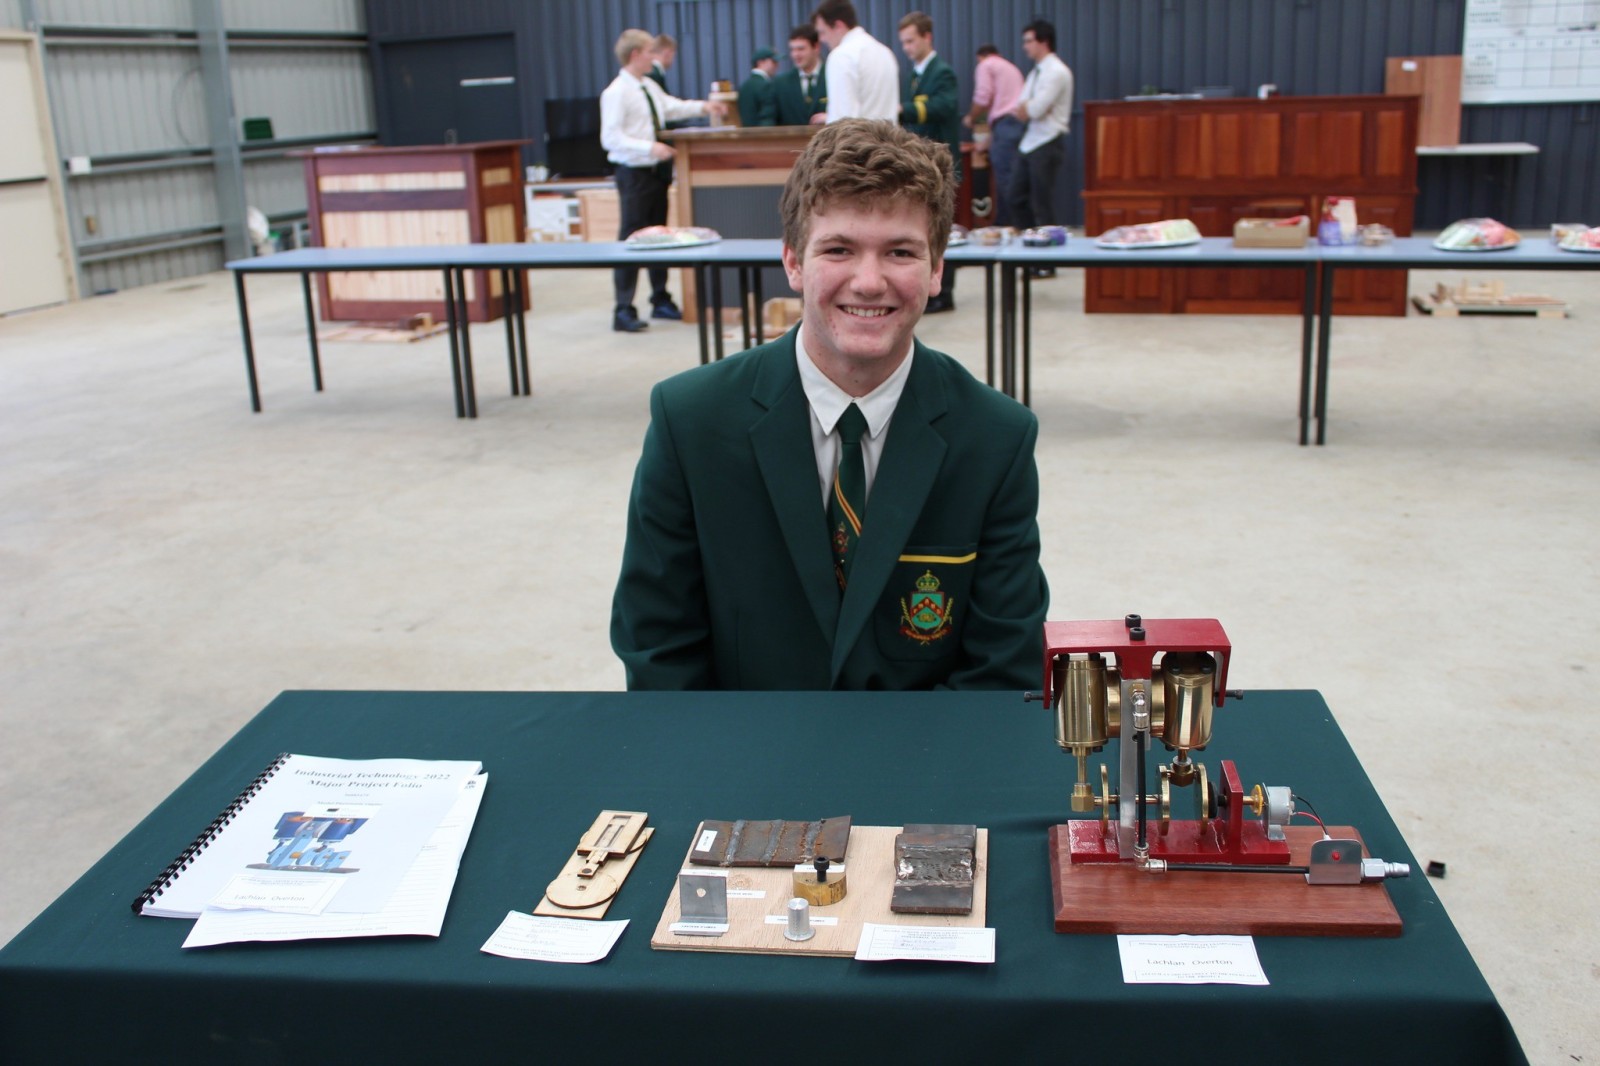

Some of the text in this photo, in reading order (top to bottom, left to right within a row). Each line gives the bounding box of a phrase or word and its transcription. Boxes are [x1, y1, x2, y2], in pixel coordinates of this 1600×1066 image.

[294, 769, 352, 779] Industrial
[355, 772, 419, 780] Technology
[307, 780, 344, 788] Major
[347, 781, 390, 789] Project
[1147, 958, 1185, 966] Lachlan
